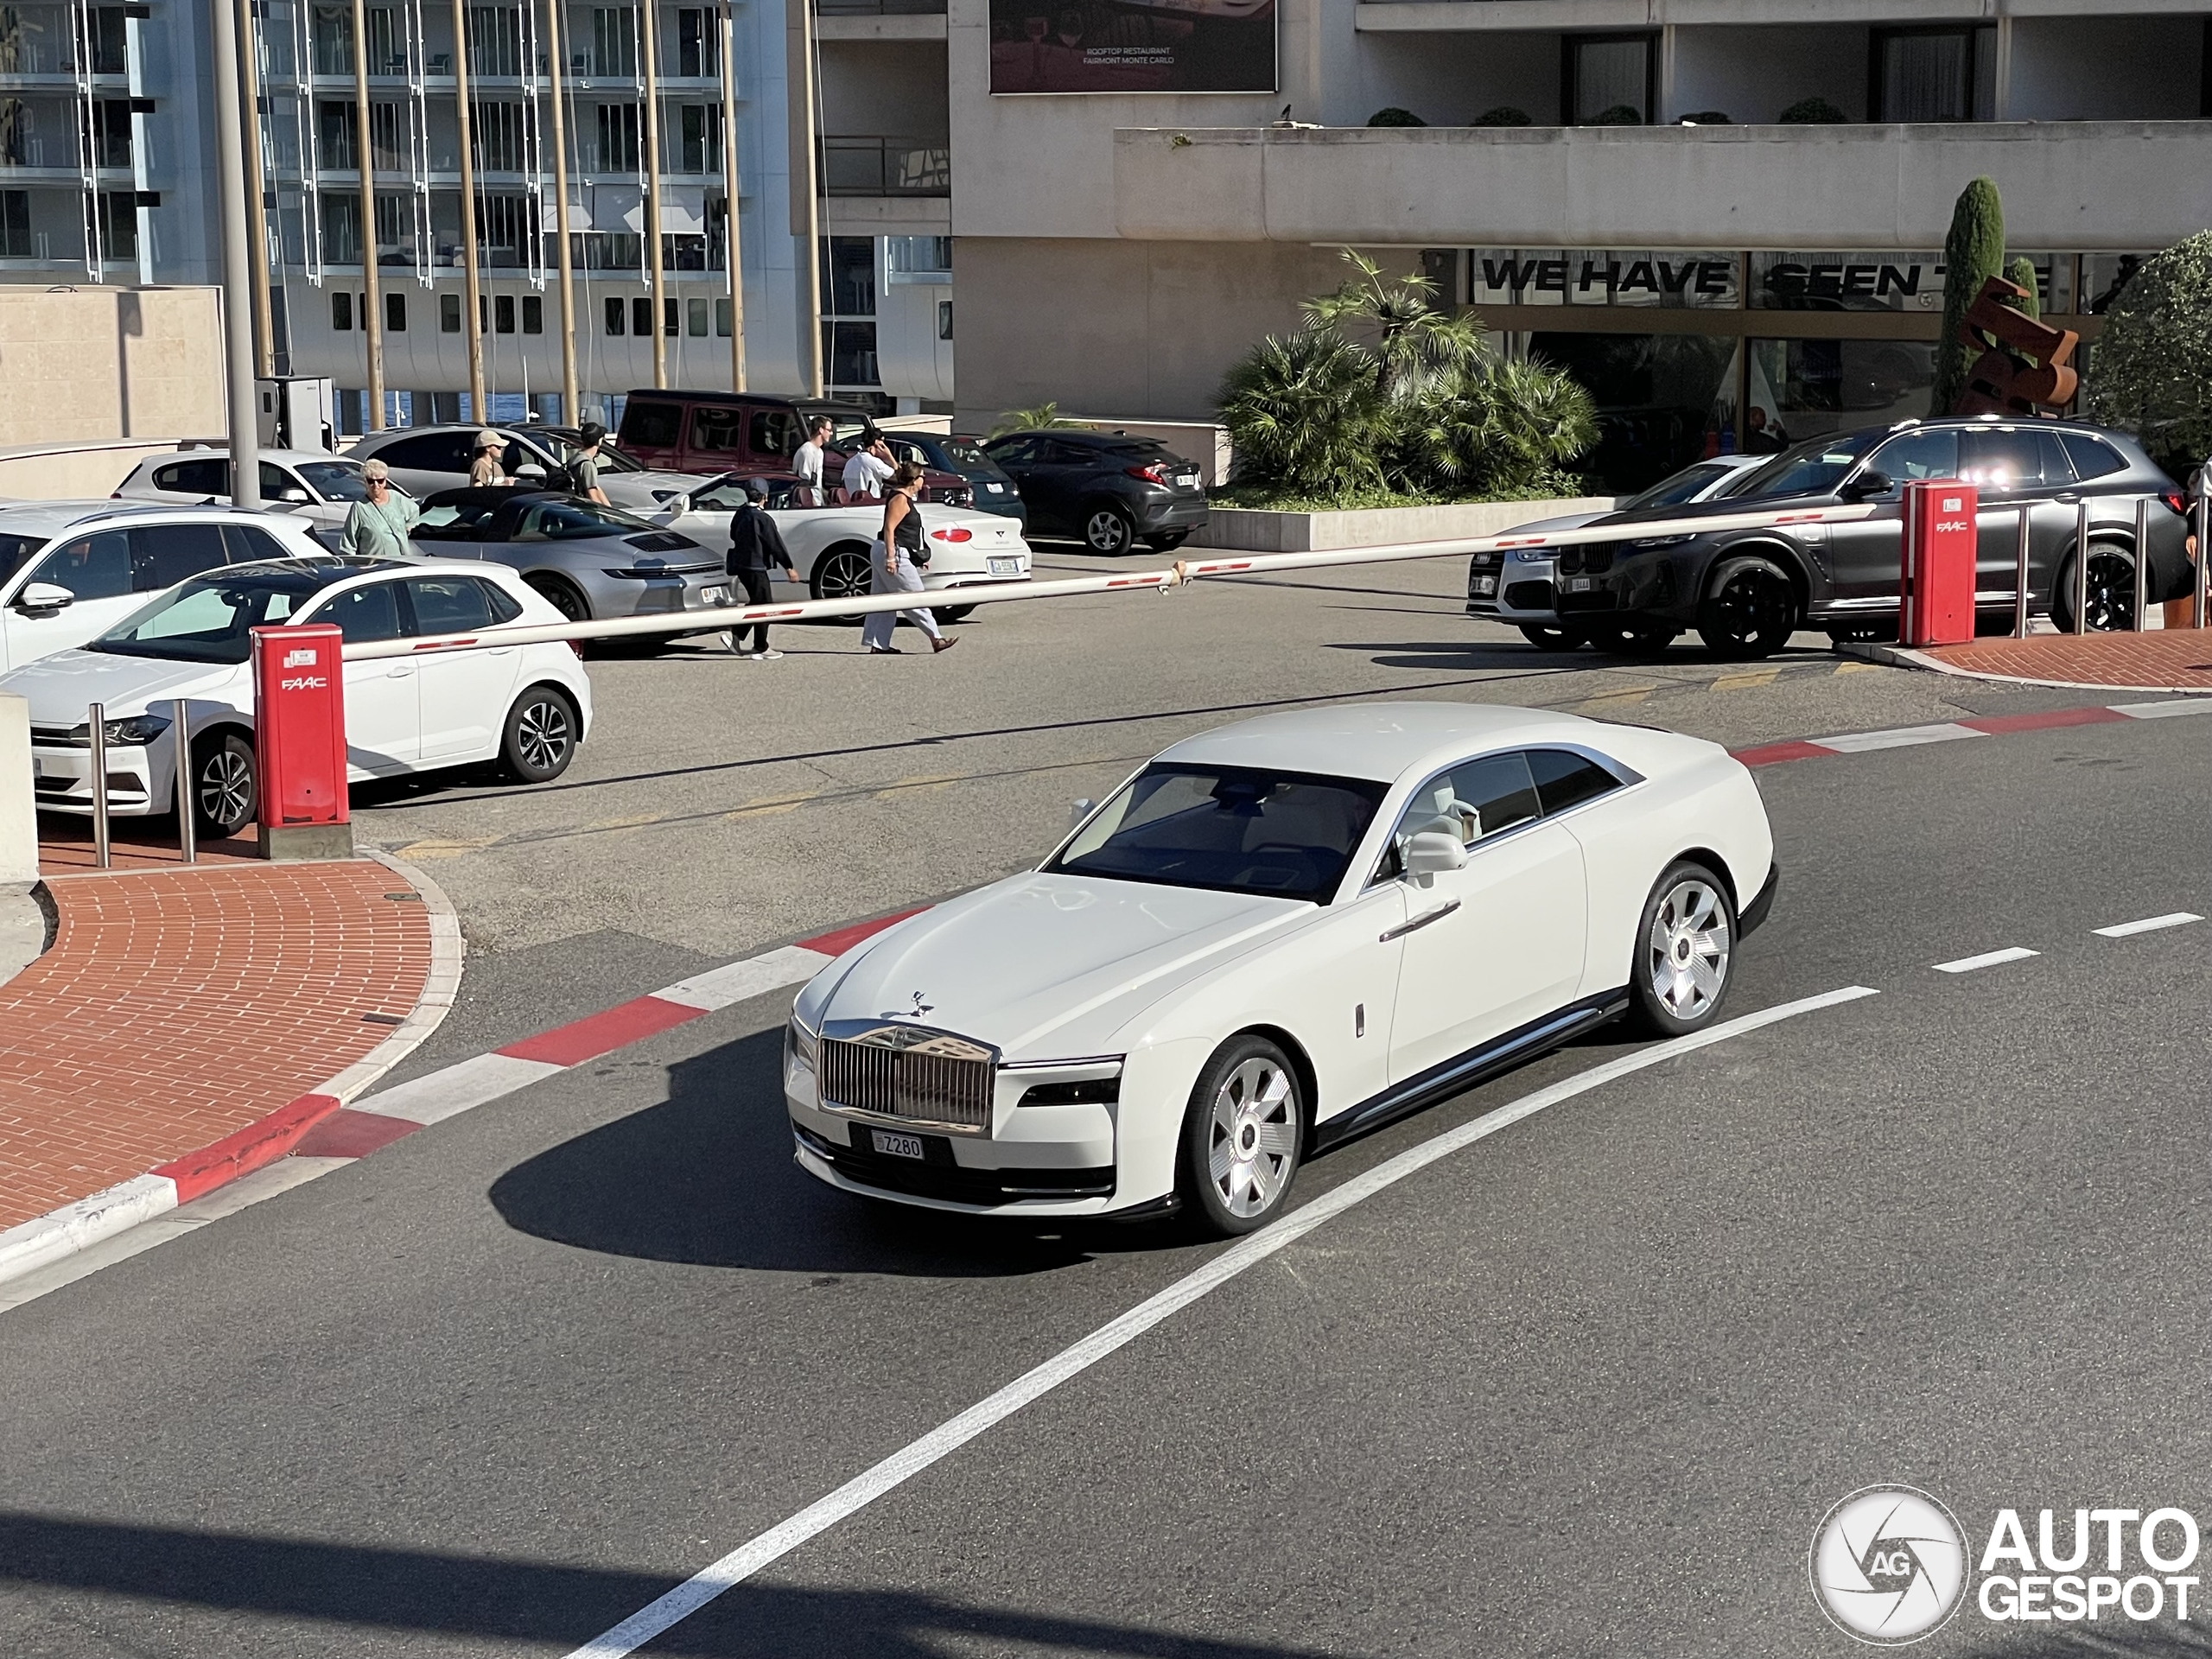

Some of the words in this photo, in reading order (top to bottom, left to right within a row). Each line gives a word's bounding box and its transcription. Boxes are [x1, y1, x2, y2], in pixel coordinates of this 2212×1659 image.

[1123, 47, 1170, 55] RESTAURANT
[1483, 259, 1569, 290] WE
[1579, 261, 1731, 294] HAVE
[1768, 264, 1921, 296] SEEN
[1936, 521, 1967, 532] FAAC
[282, 677, 327, 690] FAAC
[884, 1136, 920, 1156] Z280
